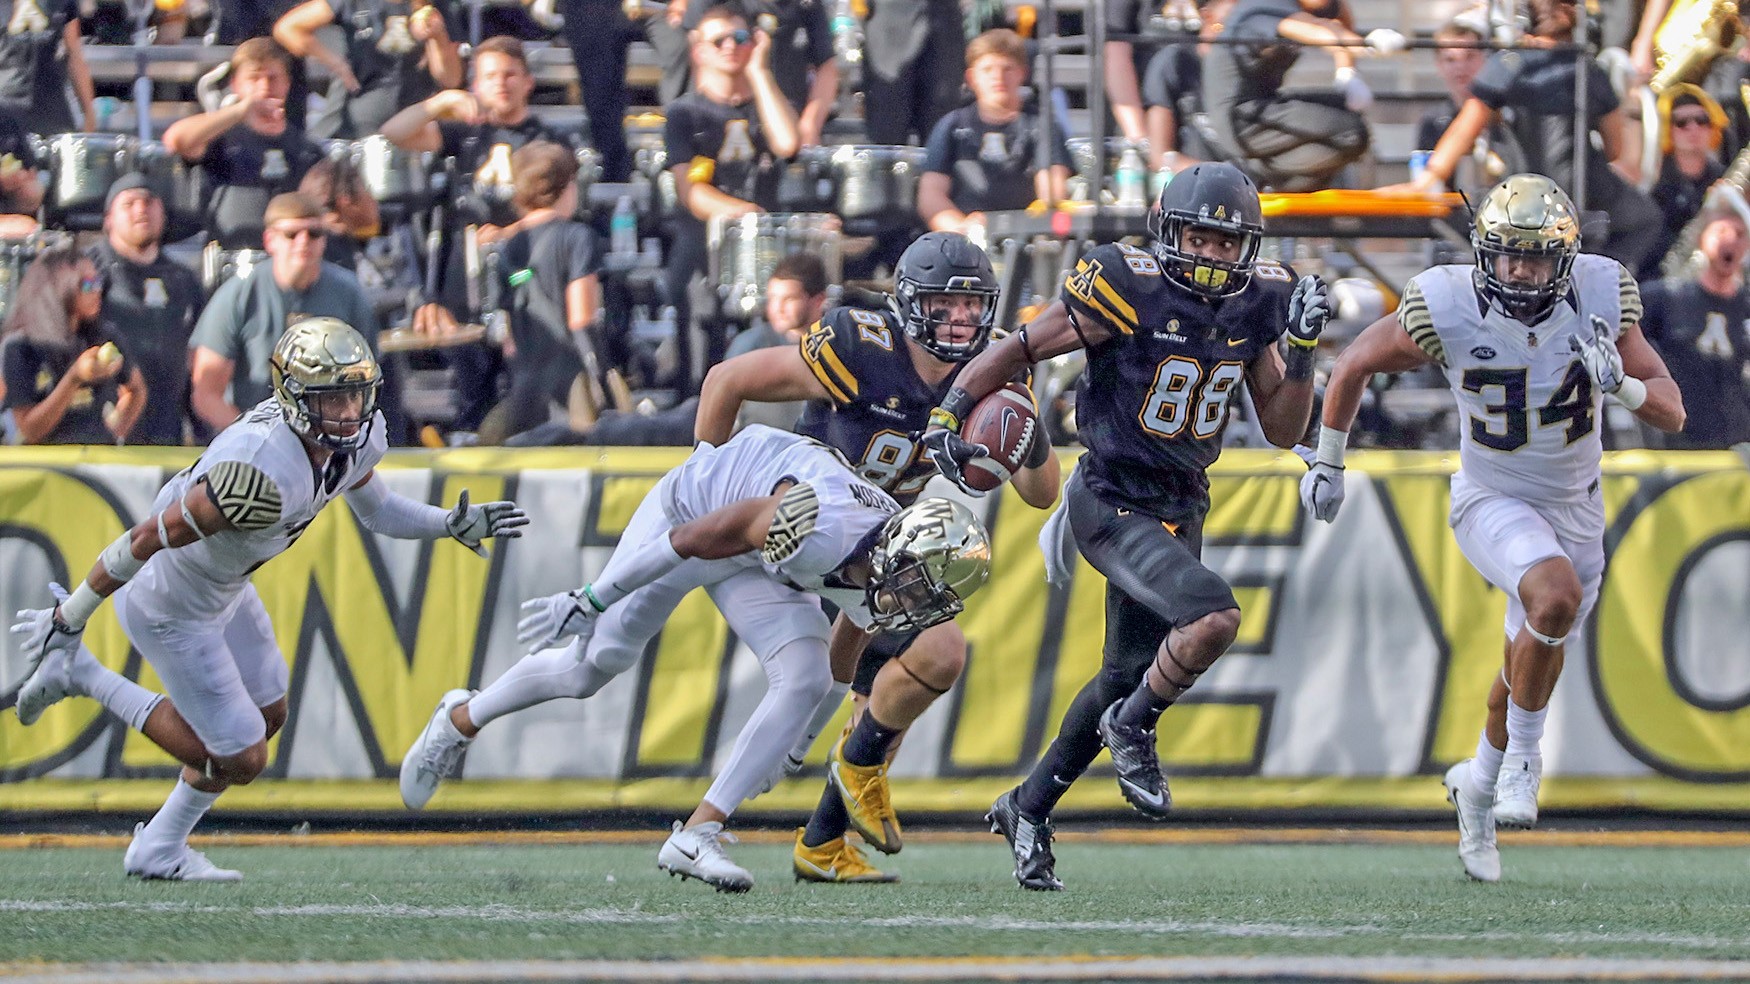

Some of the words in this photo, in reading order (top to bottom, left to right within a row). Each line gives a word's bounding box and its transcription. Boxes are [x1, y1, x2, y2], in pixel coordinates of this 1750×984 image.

[717, 119, 757, 163] A
[1069, 258, 1104, 301] A
[804, 325, 836, 362] A
[849, 309, 893, 352] 87
[1696, 311, 1734, 359] A
[1138, 354, 1244, 440] 88
[1461, 360, 1595, 453] 34
[918, 498, 954, 541] WF
